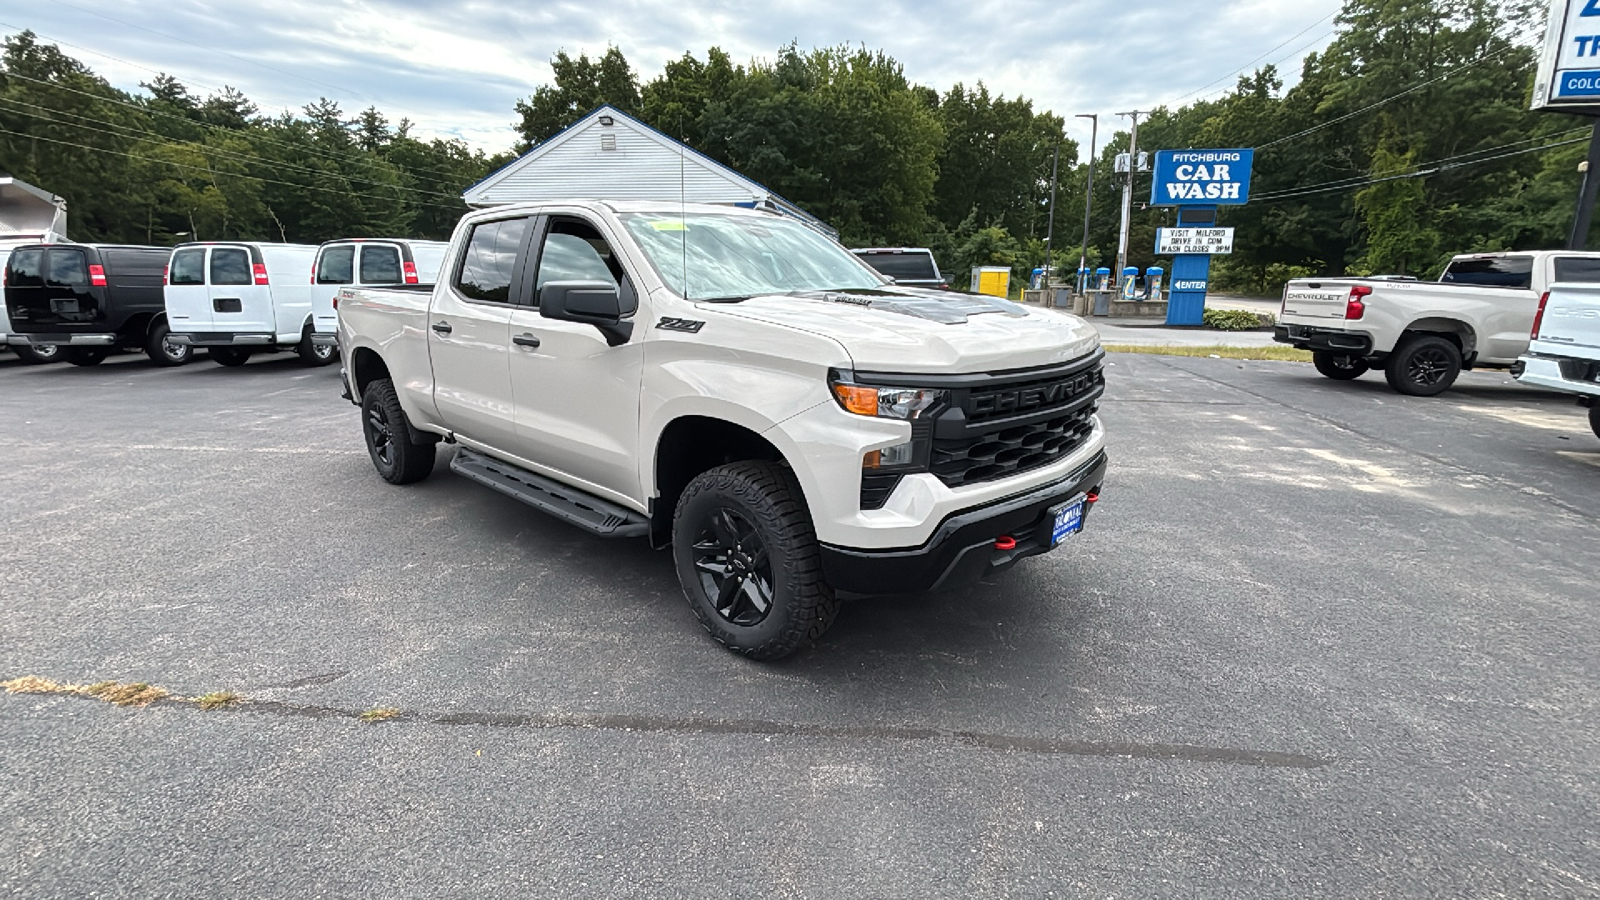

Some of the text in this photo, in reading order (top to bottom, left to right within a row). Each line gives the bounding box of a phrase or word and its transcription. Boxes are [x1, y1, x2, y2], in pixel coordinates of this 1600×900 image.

[1172, 152, 1240, 163] FITCHBURG
[1175, 164, 1231, 181] CAR
[1166, 182, 1241, 199] WASH
[1170, 229, 1226, 237] VISIT MILFORD
[1170, 237, 1192, 245] DRIVE
[1195, 237, 1203, 245] IN
[1214, 245, 1231, 253] 9PM
[1181, 281, 1206, 289] ENTER
[1287, 293, 1343, 301] CHEVROLET
